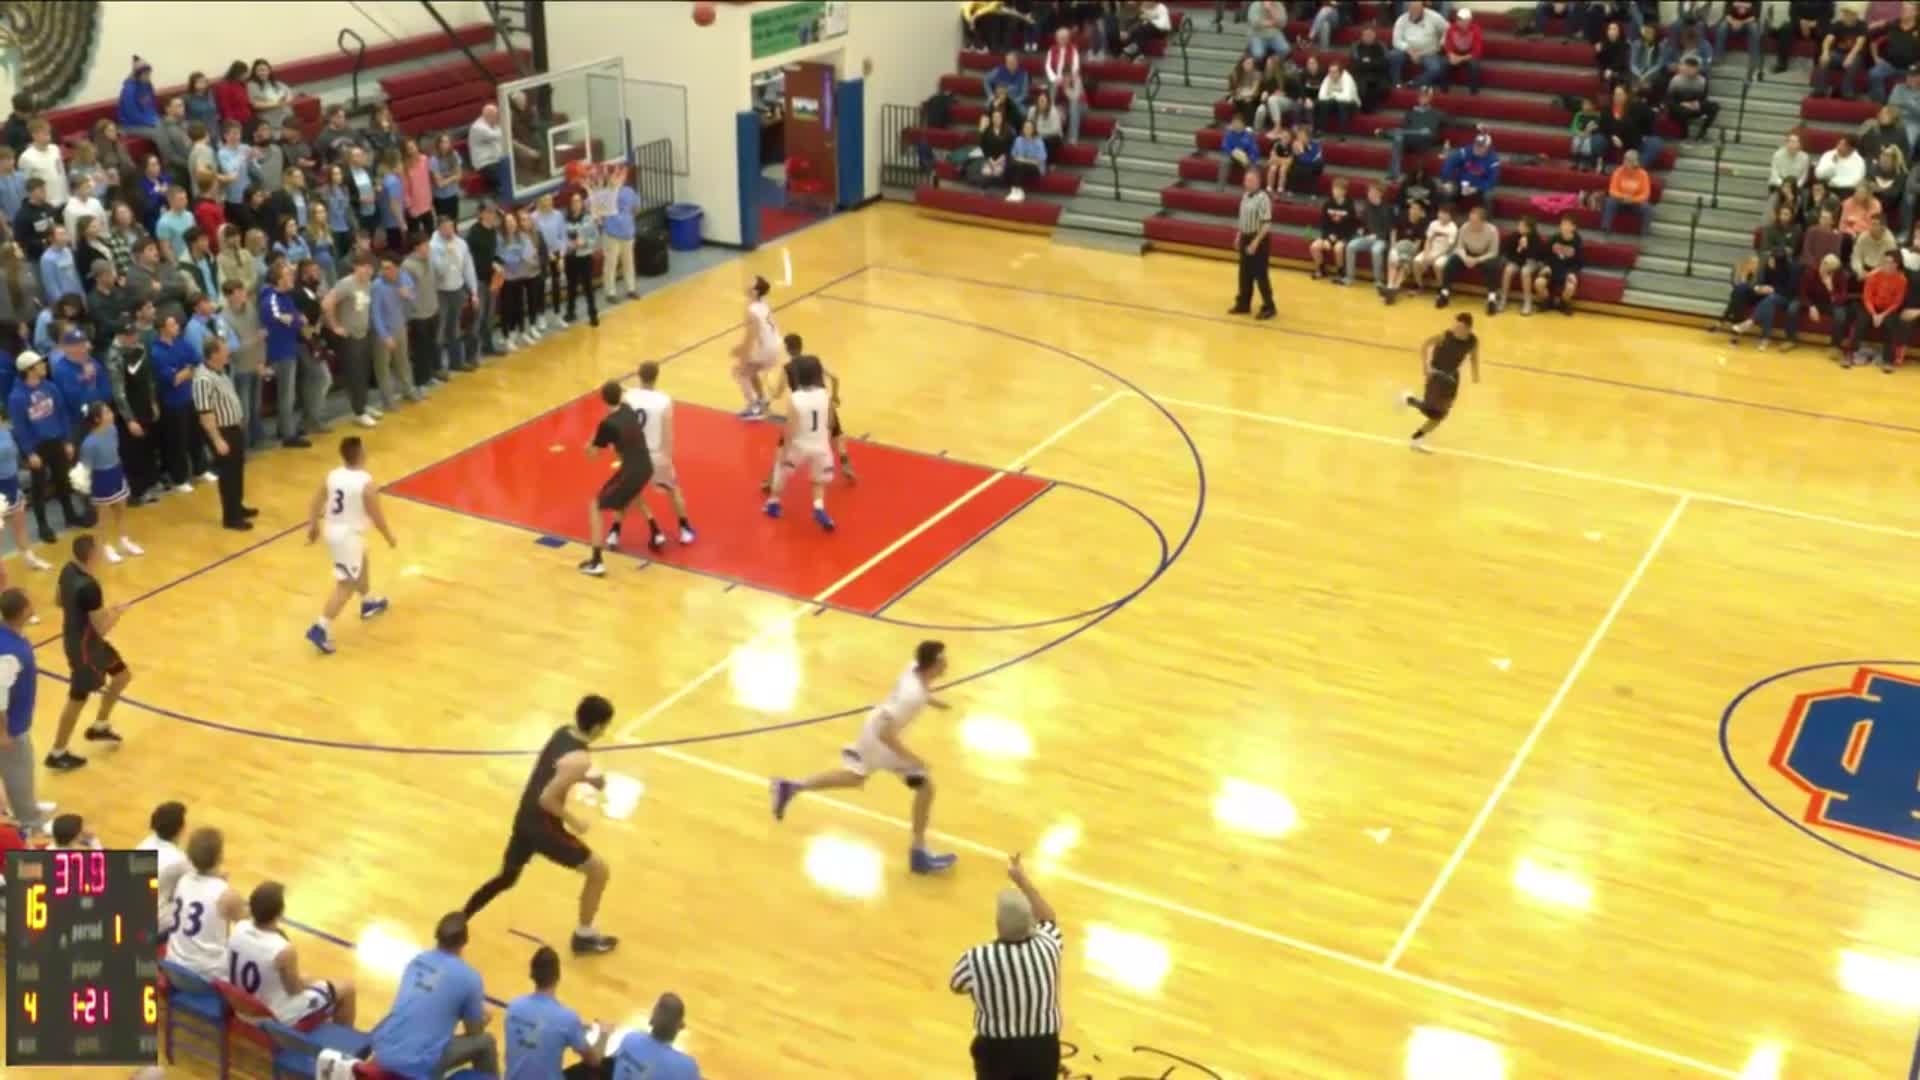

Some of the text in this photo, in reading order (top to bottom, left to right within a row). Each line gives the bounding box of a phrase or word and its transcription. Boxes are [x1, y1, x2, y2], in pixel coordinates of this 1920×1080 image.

[331, 488, 345, 516] 3
[168, 897, 204, 936] 33
[230, 950, 261, 993] 10
